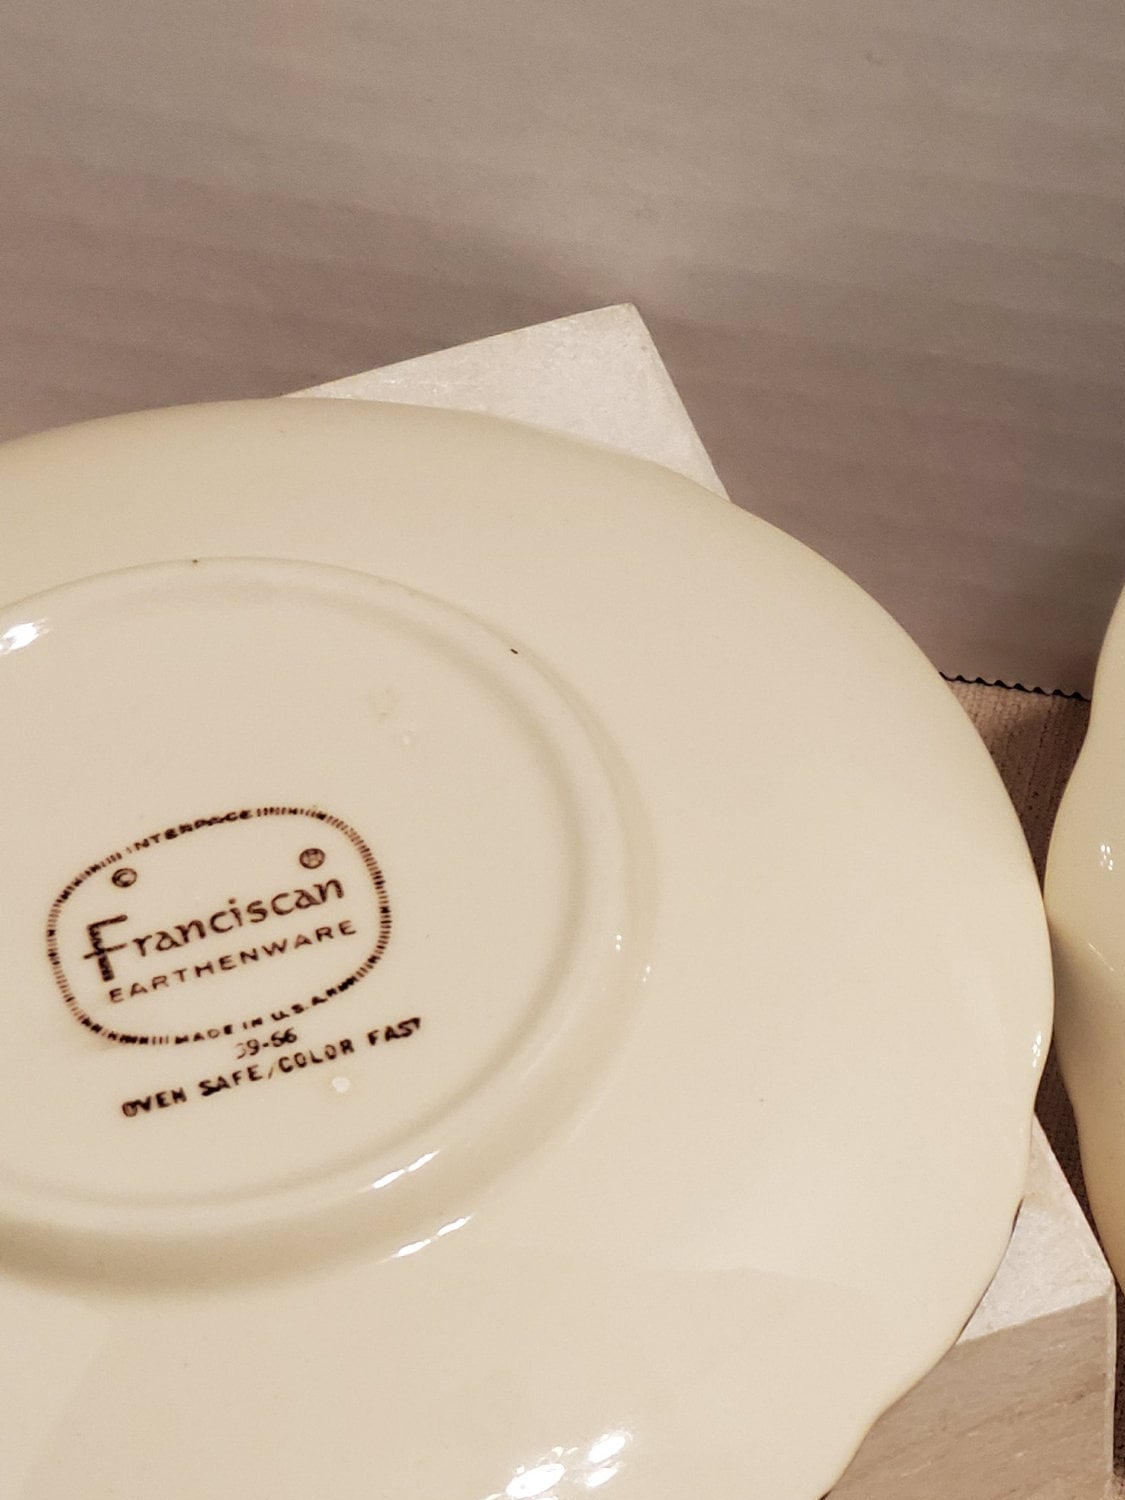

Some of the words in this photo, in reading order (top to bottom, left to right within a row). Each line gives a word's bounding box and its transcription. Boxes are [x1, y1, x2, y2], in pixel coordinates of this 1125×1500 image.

[83, 877, 345, 982] Franciscan
[109, 920, 357, 1003] EARTHENWARE
[122, 1086, 187, 1118] OVEN
[367, 1016, 422, 1046] FAST
[174, 1024, 233, 1045] MADE
